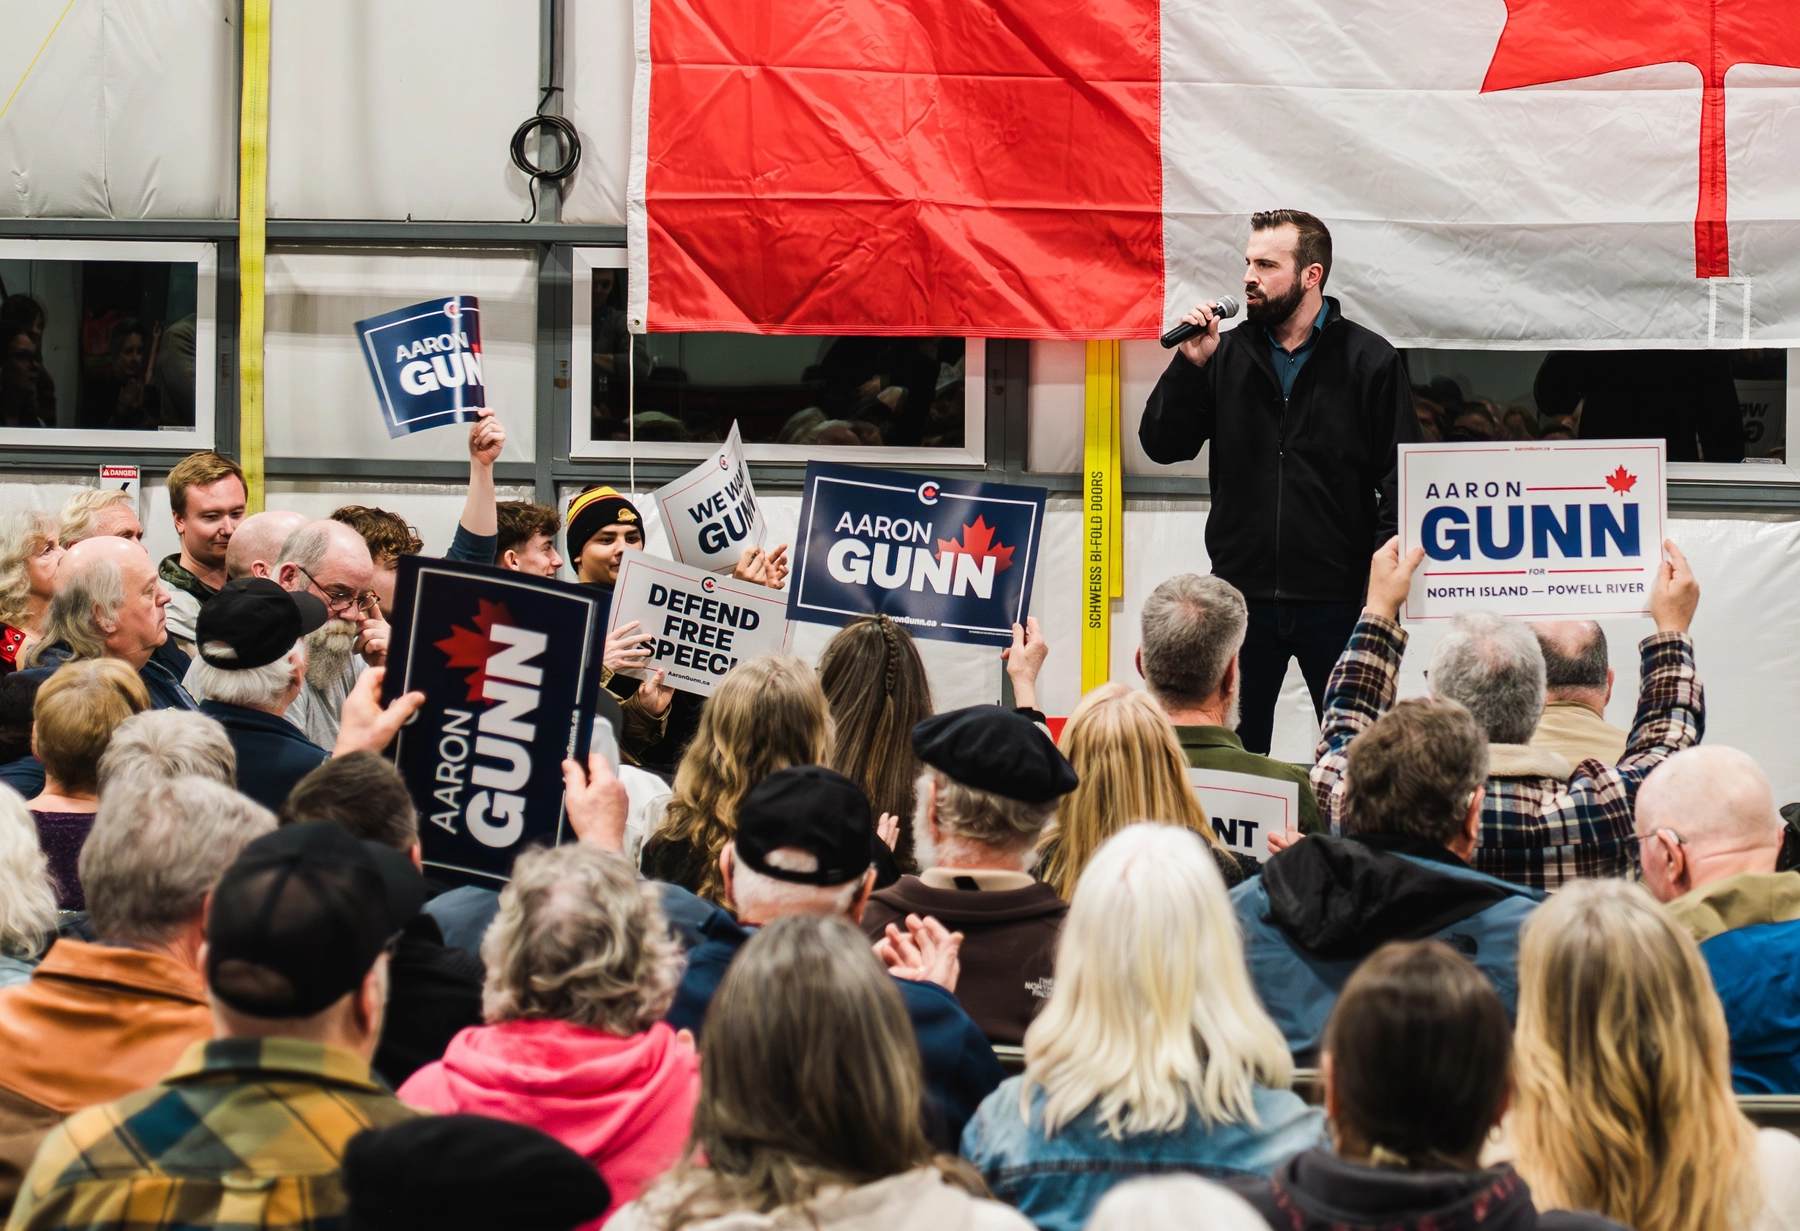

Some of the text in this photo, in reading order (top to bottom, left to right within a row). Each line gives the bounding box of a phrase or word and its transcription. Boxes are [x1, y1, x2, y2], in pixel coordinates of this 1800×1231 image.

[396, 332, 470, 363] AARON
[399, 352, 484, 396] GUN
[688, 490, 728, 524] WE
[1426, 481, 1522, 499] AARON
[834, 511, 932, 544] AARON
[1420, 503, 1641, 562] GUNN
[1089, 472, 1103, 628] SCHWEISS BI-FOLD DOORS
[826, 538, 997, 600] GUNN
[648, 583, 760, 630] DEFEND
[1427, 587, 1474, 598] NORTH
[1480, 586, 1528, 597] ISLAND
[1548, 584, 1602, 596] POWELL
[1606, 583, 1645, 594] RIVER
[662, 614, 734, 652] FREE
[889, 616, 938, 628] ronGunn.ca
[668, 671, 710, 686] AaronGunn.ca
[466, 624, 548, 848] GUNN
[430, 708, 474, 835] AARON
[1212, 816, 1259, 848] NT
